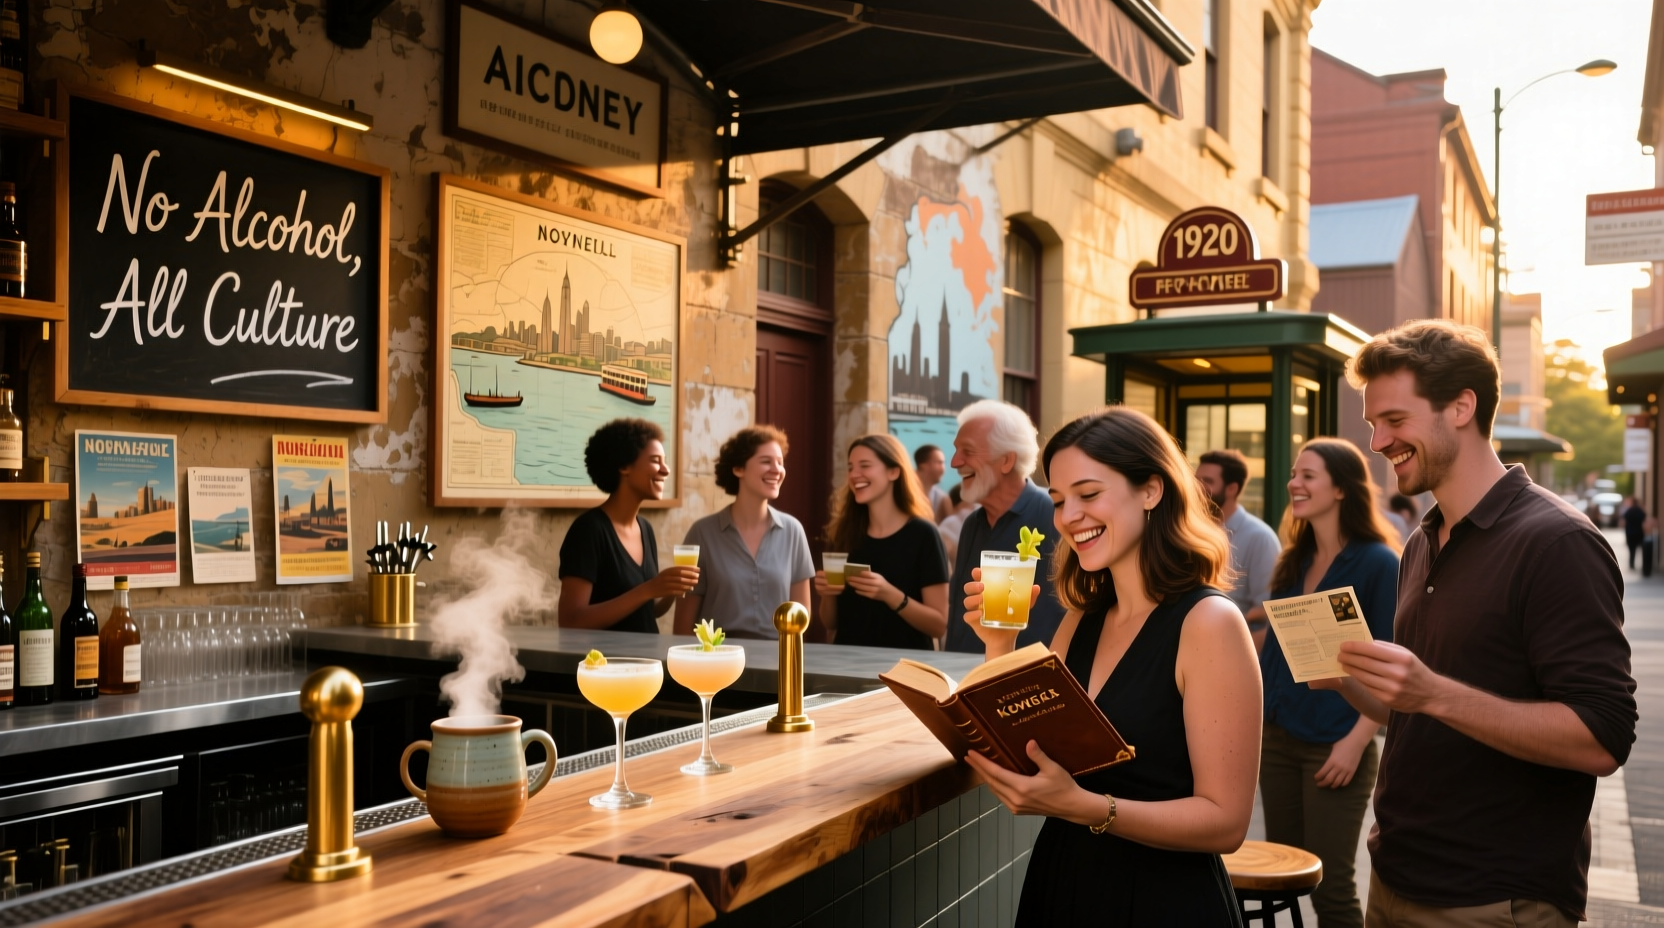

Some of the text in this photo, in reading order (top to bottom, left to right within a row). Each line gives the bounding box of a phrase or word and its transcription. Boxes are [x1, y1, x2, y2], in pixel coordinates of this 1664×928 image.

[483, 45, 643, 136] AICDNEY
[97, 150, 179, 234] No
[185, 170, 362, 277] Alcohol,
[1173, 222, 1239, 259] 1920
[90, 258, 358, 353] All Culture
